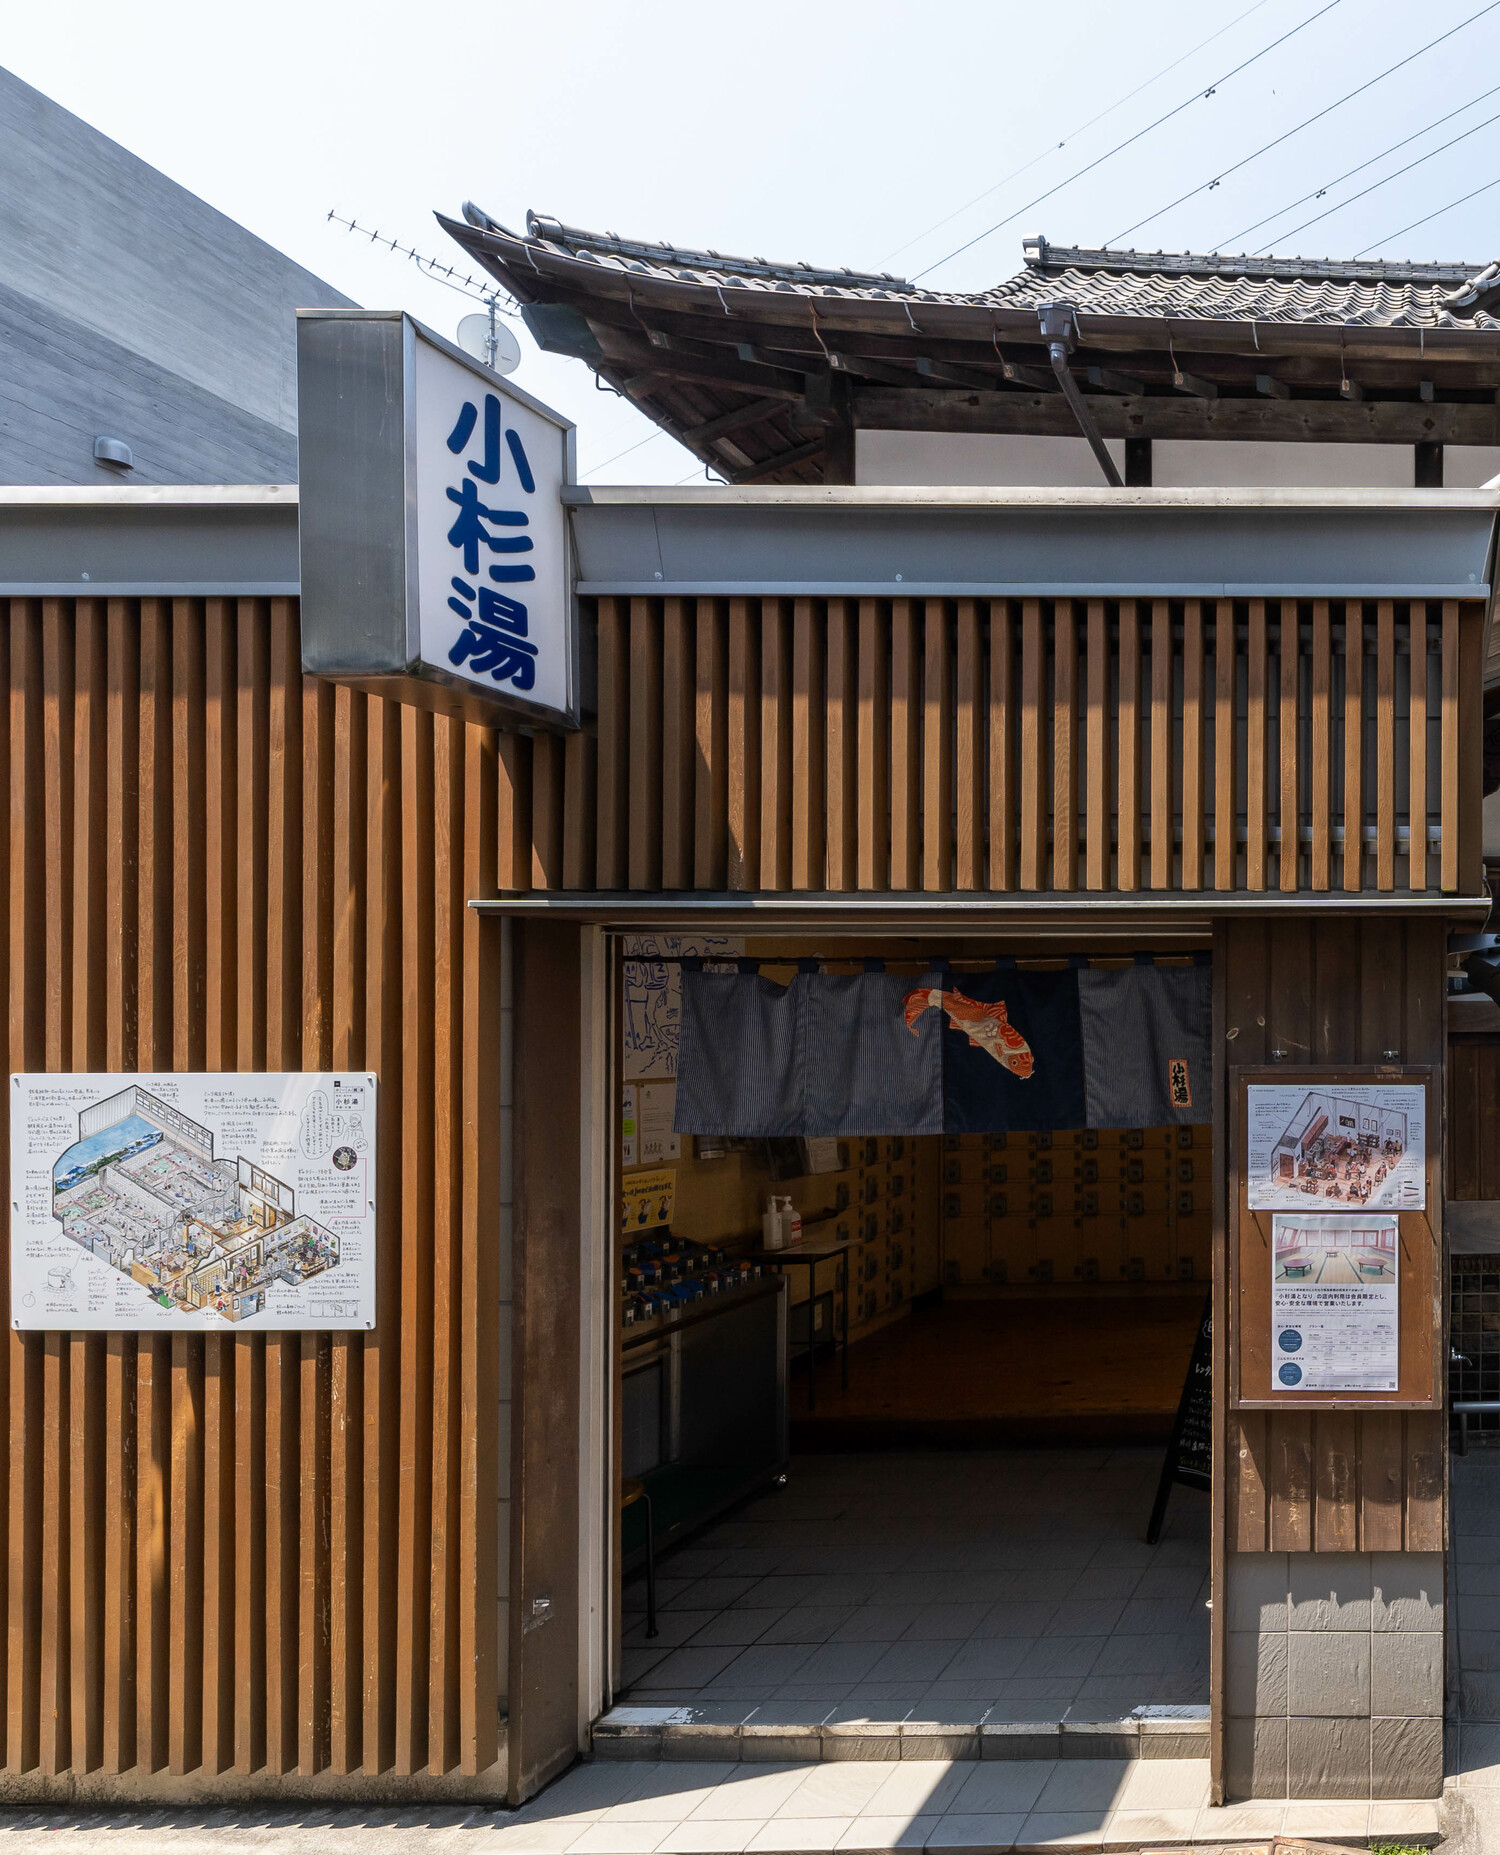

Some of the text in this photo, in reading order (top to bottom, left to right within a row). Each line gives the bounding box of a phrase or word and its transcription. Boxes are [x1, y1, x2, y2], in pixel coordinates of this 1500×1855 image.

[447, 393, 538, 691] 小杉湯
[1172, 1062, 1189, 1104] 小杉湯
[1195, 1362, 1212, 1377] レンタ
